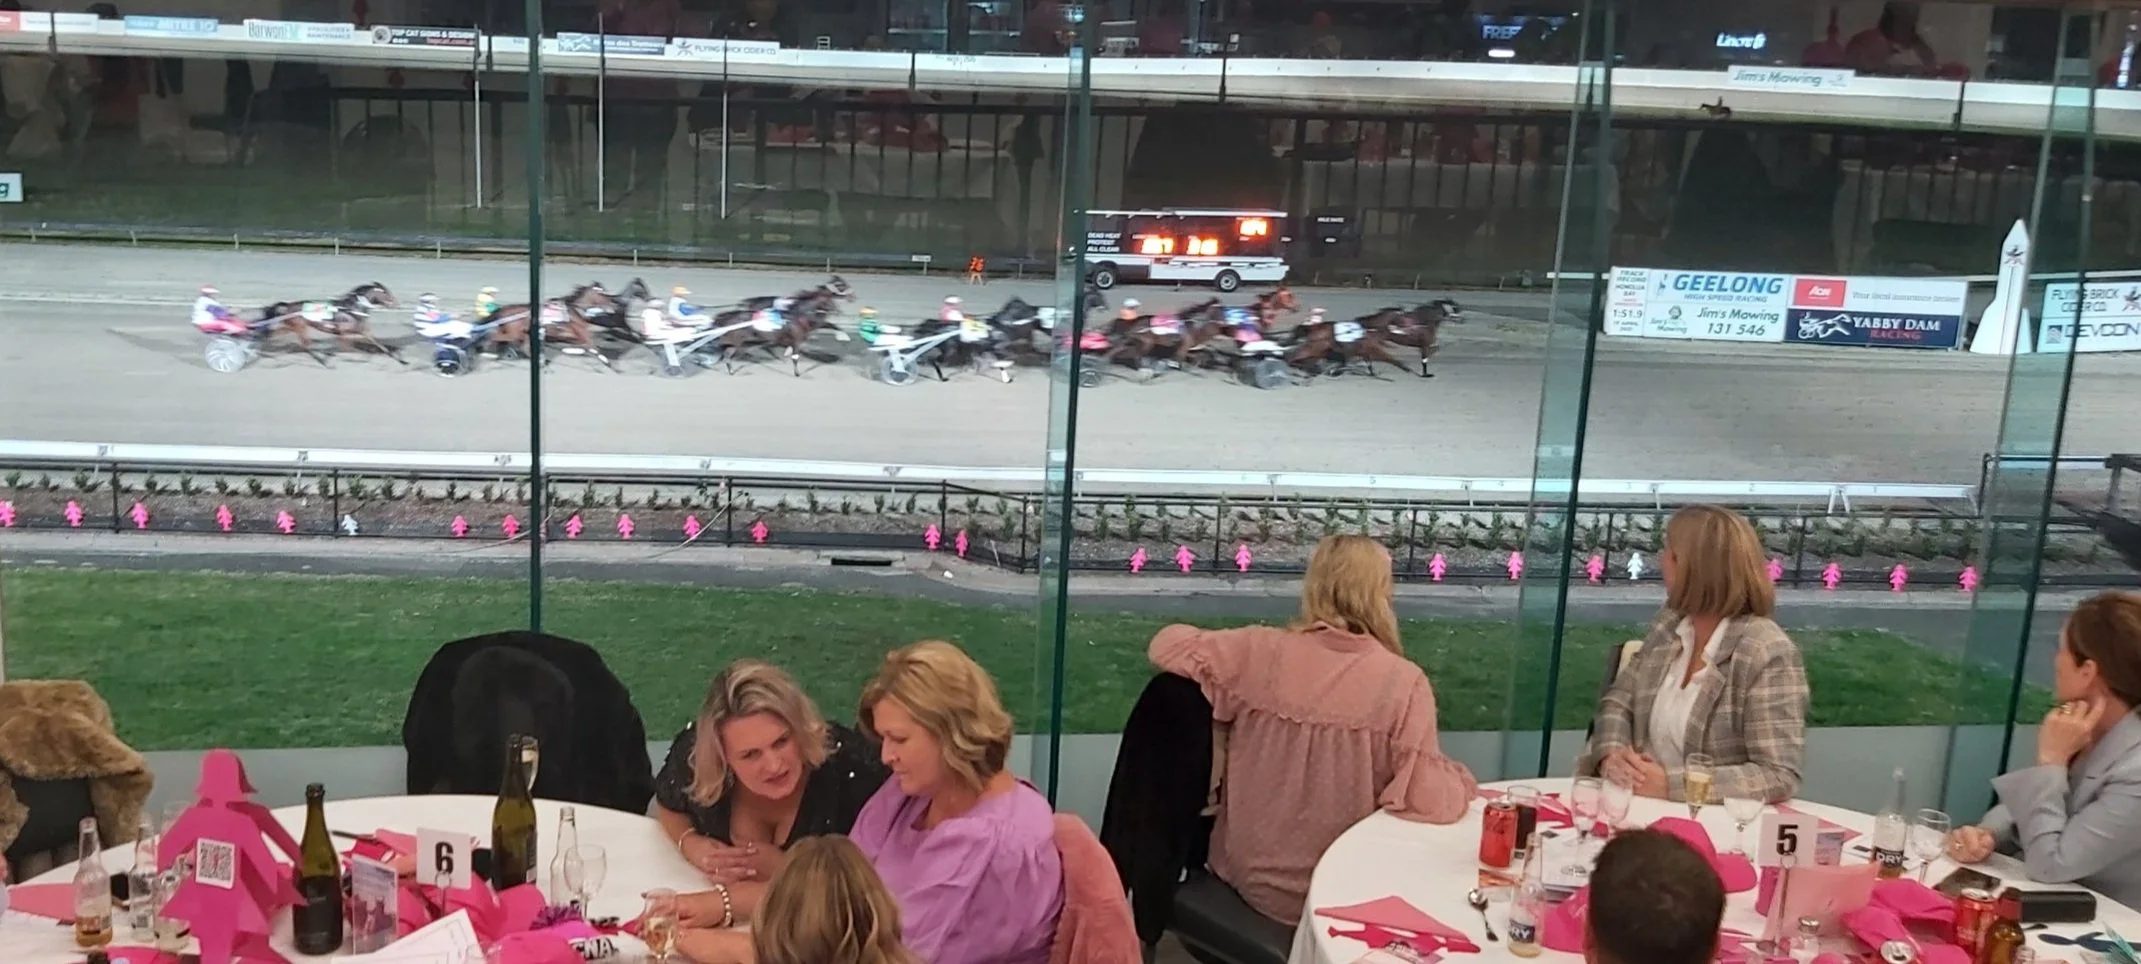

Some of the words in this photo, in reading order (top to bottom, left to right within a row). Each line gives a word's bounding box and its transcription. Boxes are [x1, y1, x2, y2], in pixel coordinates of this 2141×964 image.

[406, 29, 419, 37] CAT
[1767, 71, 1822, 87] Mowing
[1672, 273, 1784, 294] GEELONG
[1684, 293, 1706, 301] HIGH
[1708, 294, 1734, 302] SPEED
[1735, 295, 1768, 303] RACING
[2090, 288, 2120, 299] BRICK
[1697, 307, 1726, 319] Jim's
[1728, 308, 1780, 324] Mowing
[1708, 323, 1731, 334] 131
[1736, 324, 1765, 336] 546
[1852, 316, 1902, 330] YABBY
[1905, 319, 1941, 331] DAM
[1870, 330, 1922, 341] RACING
[1776, 824, 1799, 855] 5
[435, 842, 454, 874] 6
[1875, 851, 1902, 865] DRY
[1509, 926, 1530, 940] RY
